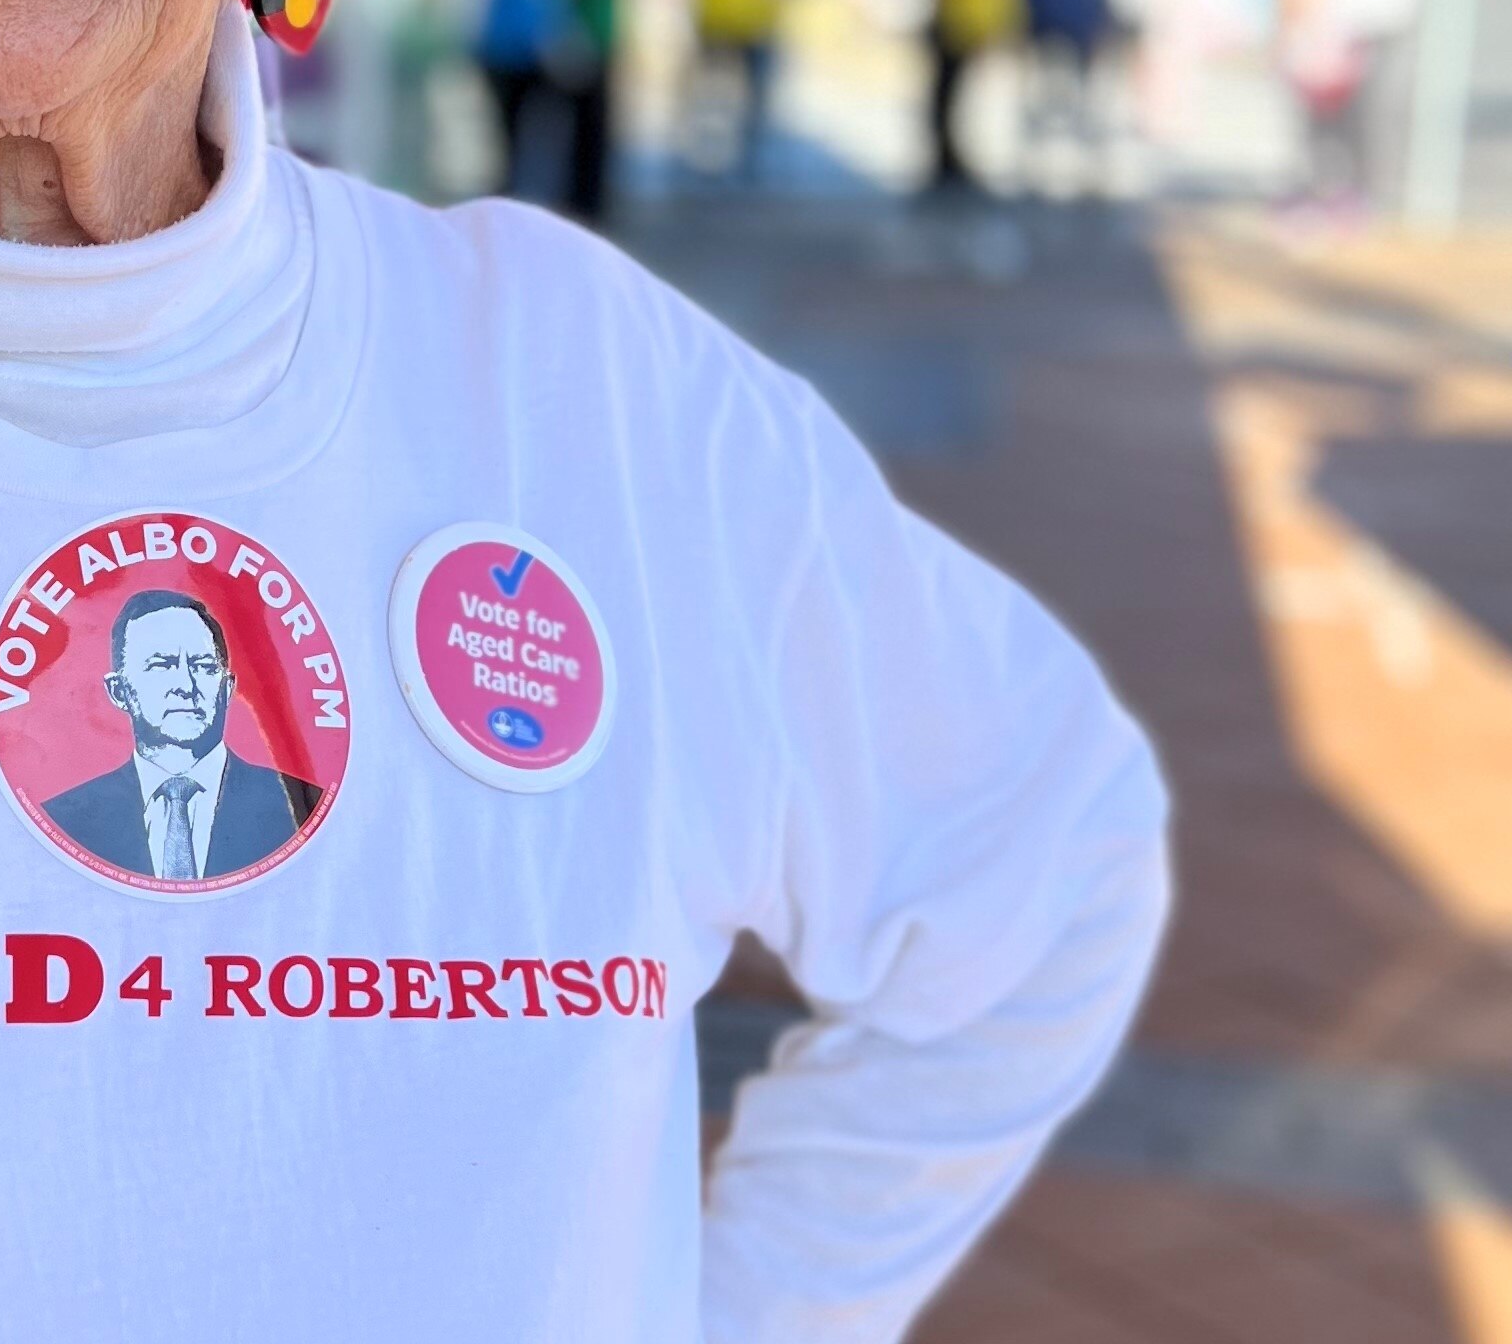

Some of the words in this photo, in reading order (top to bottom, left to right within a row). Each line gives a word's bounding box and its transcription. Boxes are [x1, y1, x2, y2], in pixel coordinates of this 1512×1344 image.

[77, 522, 217, 586] ALBO
[228, 543, 317, 646] FOR
[303, 651, 347, 729] PM
[459, 591, 520, 631] Vote
[527, 608, 566, 644] for
[448, 622, 515, 663] Aged
[520, 642, 581, 681] Care
[473, 662, 559, 708] Ratios
[118, 955, 173, 1018] 4
[205, 952, 667, 1021] ROBERTSON
